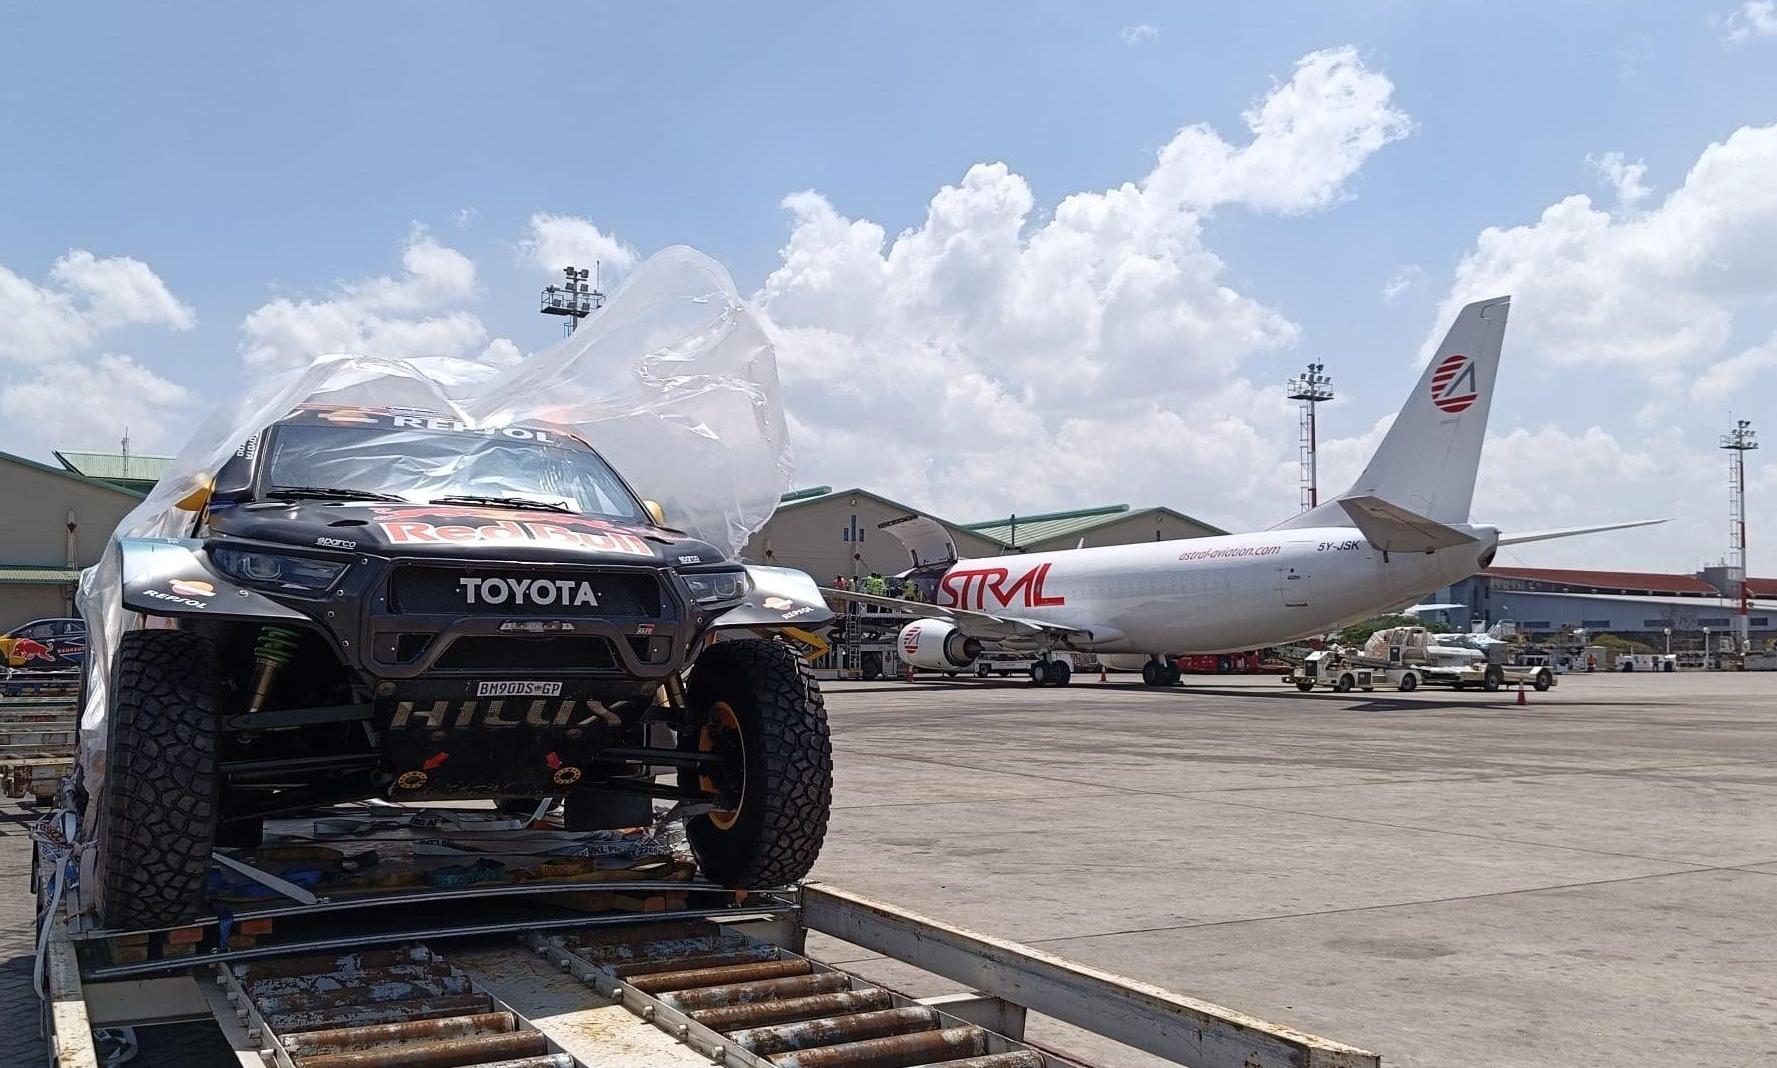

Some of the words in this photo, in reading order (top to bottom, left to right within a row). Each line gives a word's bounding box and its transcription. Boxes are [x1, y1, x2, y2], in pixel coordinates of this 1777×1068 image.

[379, 521, 526, 545] Red
[529, 521, 655, 557] Bull
[1317, 541, 1361, 552] 5Y-JSK
[1178, 544, 1282, 561] astral-aviation.com
[142, 589, 208, 609] REPSOL
[459, 577, 599, 607] TOYOTA
[390, 700, 631, 729] HILUX
